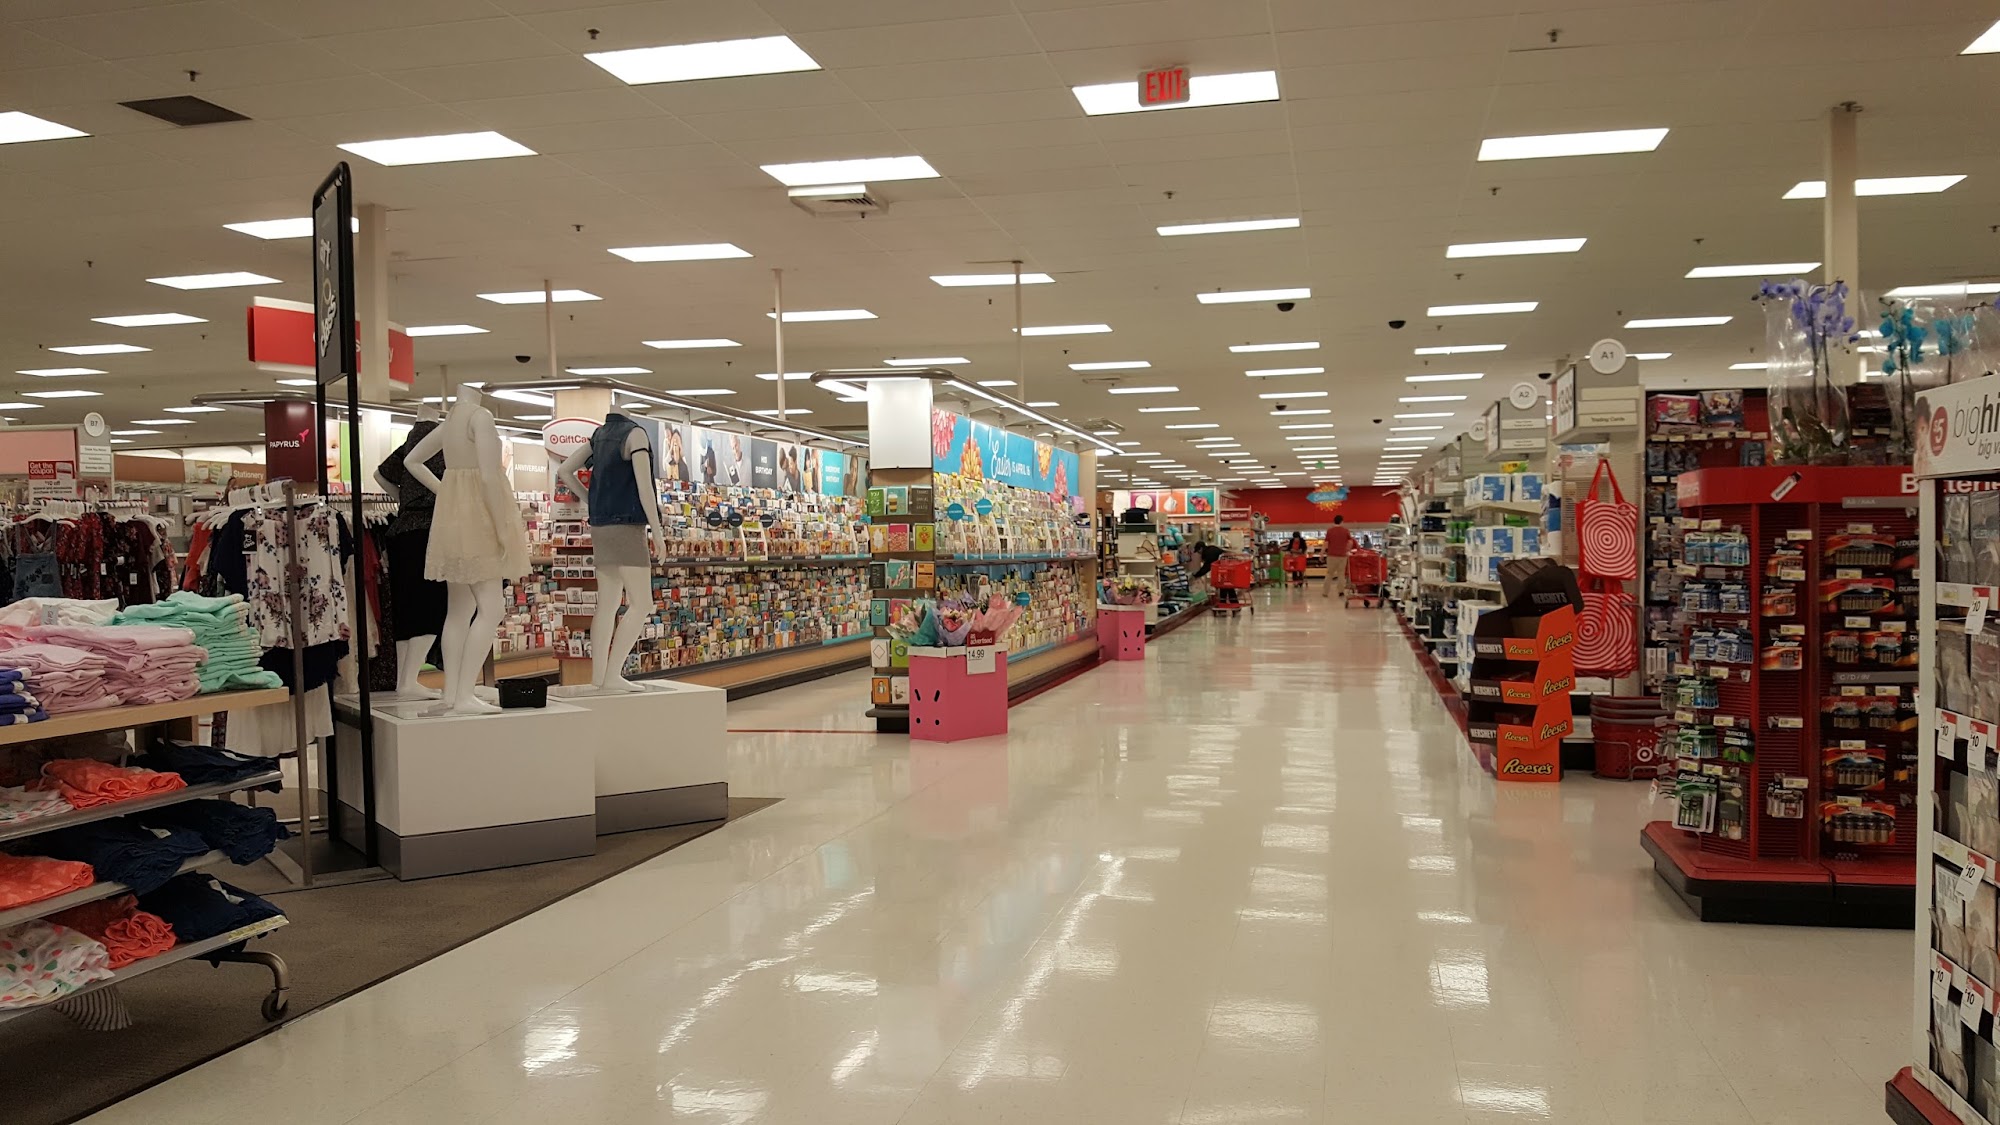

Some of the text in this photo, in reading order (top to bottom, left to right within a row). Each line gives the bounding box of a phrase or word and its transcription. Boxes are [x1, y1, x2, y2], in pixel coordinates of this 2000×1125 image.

[1145, 68, 1183, 103] EXIT
[1601, 350, 1615, 360] A1
[1518, 390, 1530, 399] A2
[1932, 417, 1945, 444] $5
[269, 440, 300, 448] PAPYRUS
[559, 434, 590, 444] GiftCa
[1977, 438, 1993, 460] big
[42, 462, 54, 470] the
[514, 463, 547, 473] ANNIVERSARY
[755, 466, 773, 476] BIRTHDAY
[233, 469, 264, 480] Stationery
[1531, 592, 1567, 605] HERSHEY'S
[970, 636, 993, 645] advertised
[1545, 632, 1573, 652] Reese's
[968, 649, 985, 659] 14.99
[1476, 643, 1503, 654] HERSHEY'S
[1509, 645, 1533, 655] Reese's
[1473, 685, 1501, 697] HERSHEY'S
[1542, 676, 1570, 697] Reese's
[1506, 688, 1531, 699] Reese's
[1540, 720, 1568, 741] Reese's
[1725, 729, 1747, 738] DURACELL
[1504, 731, 1529, 743] Reese's
[1503, 758, 1554, 775] Reese's
[1678, 772, 1710, 783] Energizer
